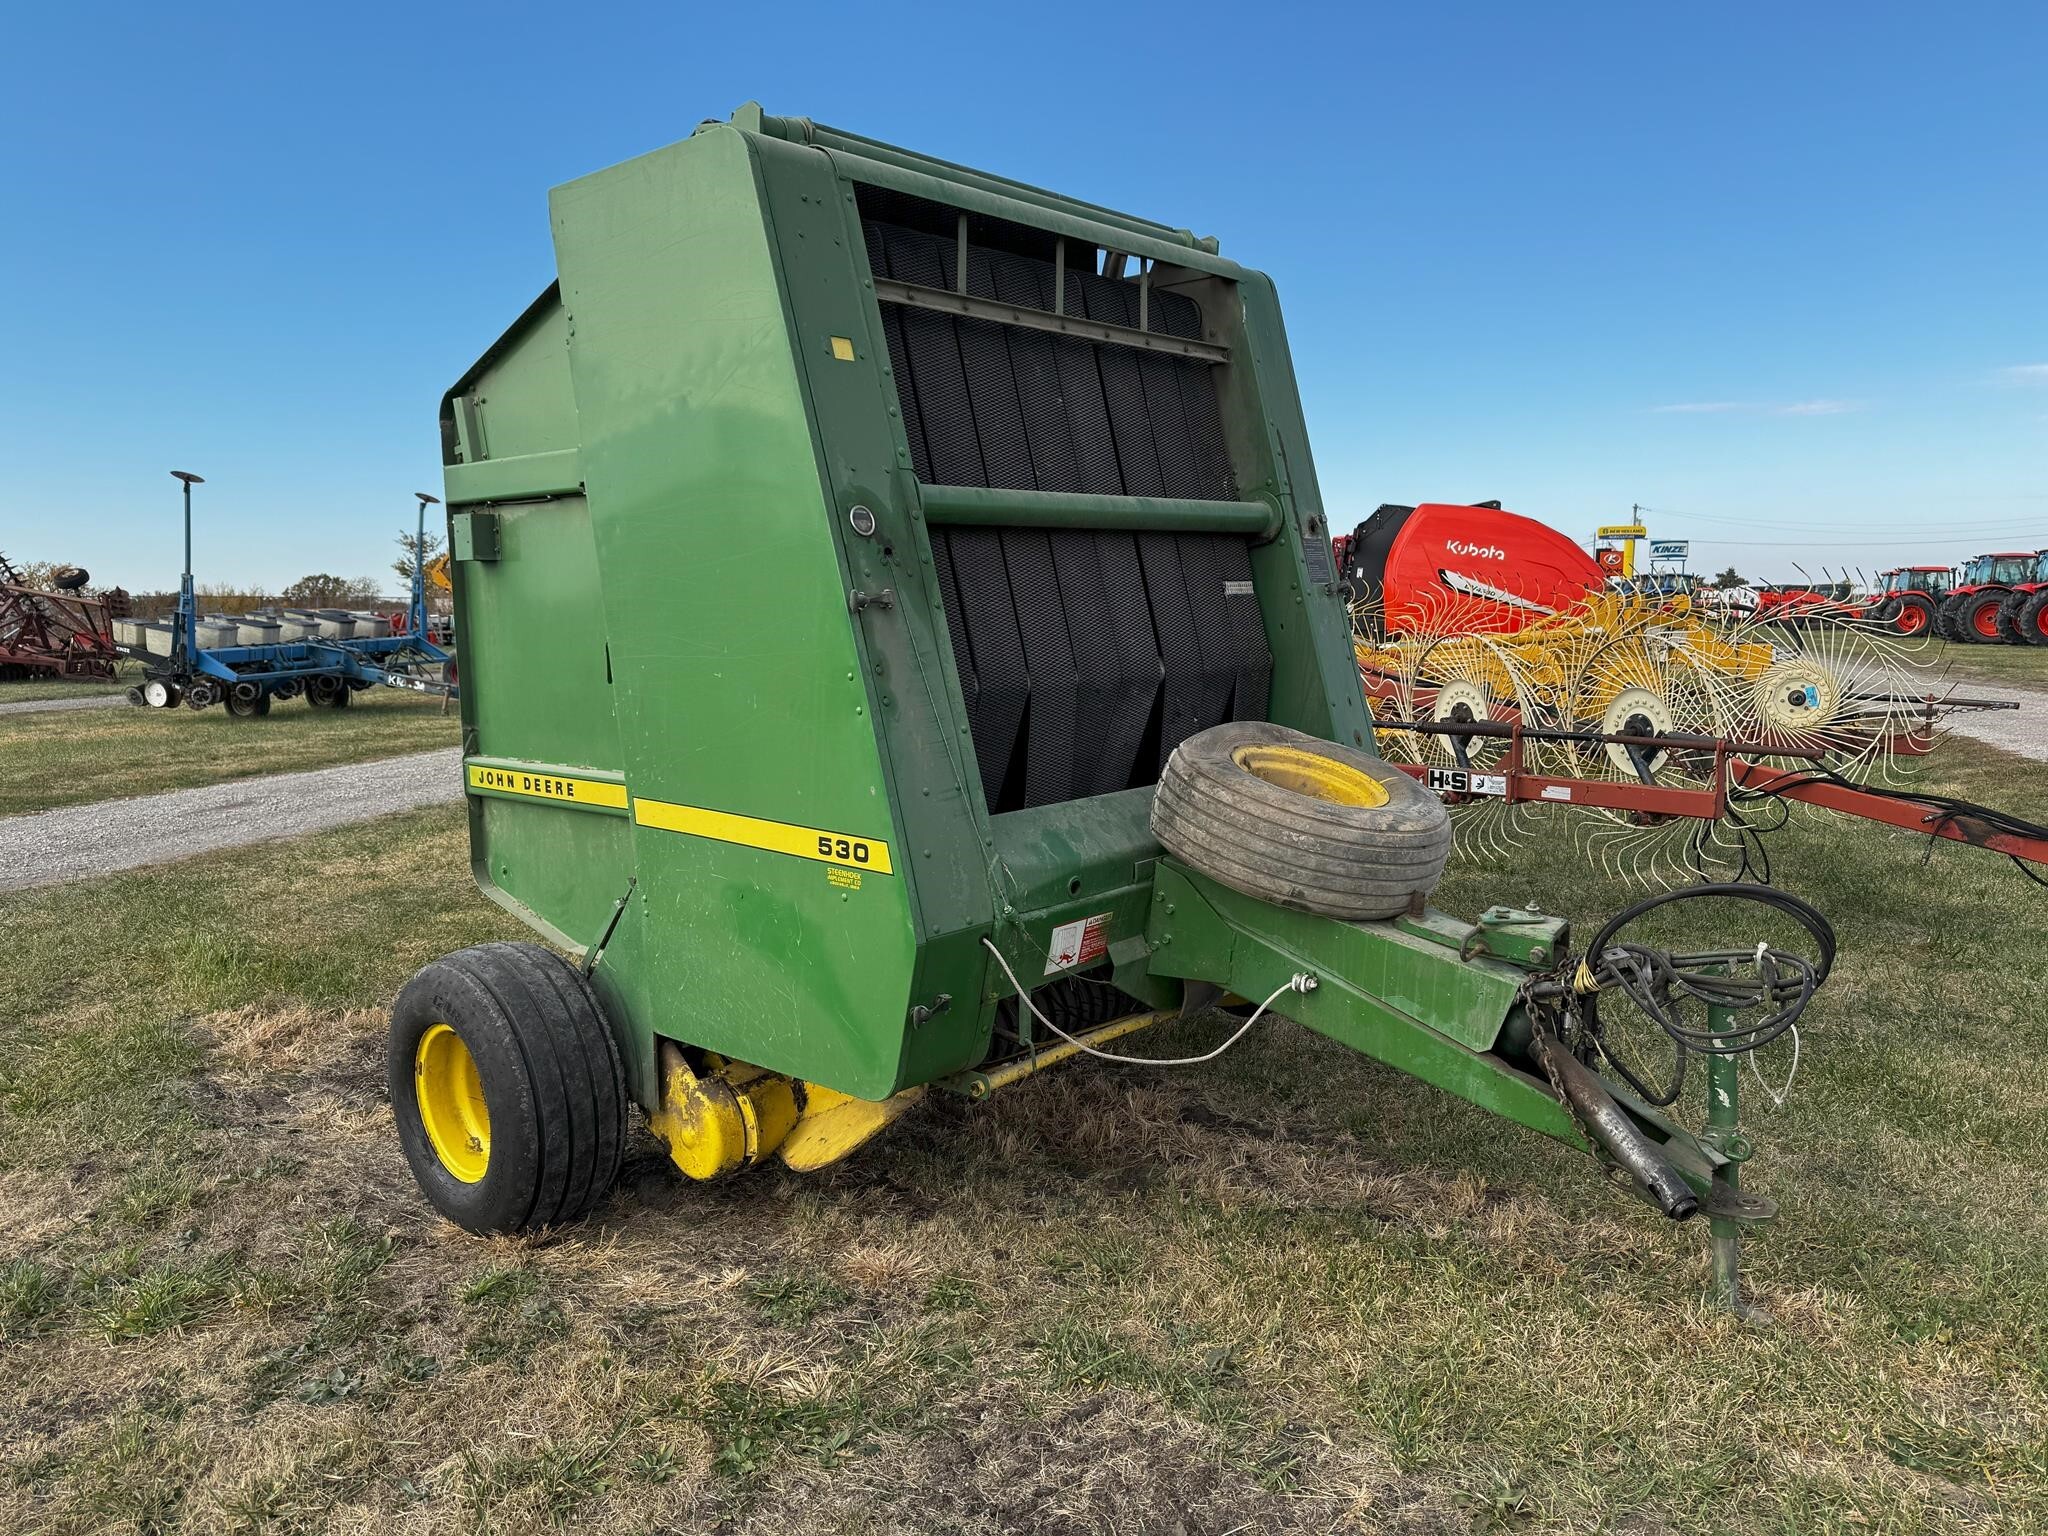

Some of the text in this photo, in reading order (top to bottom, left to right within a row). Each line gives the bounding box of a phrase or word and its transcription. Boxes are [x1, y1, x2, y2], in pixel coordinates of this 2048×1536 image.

[1446, 540, 1505, 560] Kubota
[479, 771, 574, 797] JOHN DEERE
[1429, 770, 1467, 790] H&S
[818, 836, 869, 863] 530
